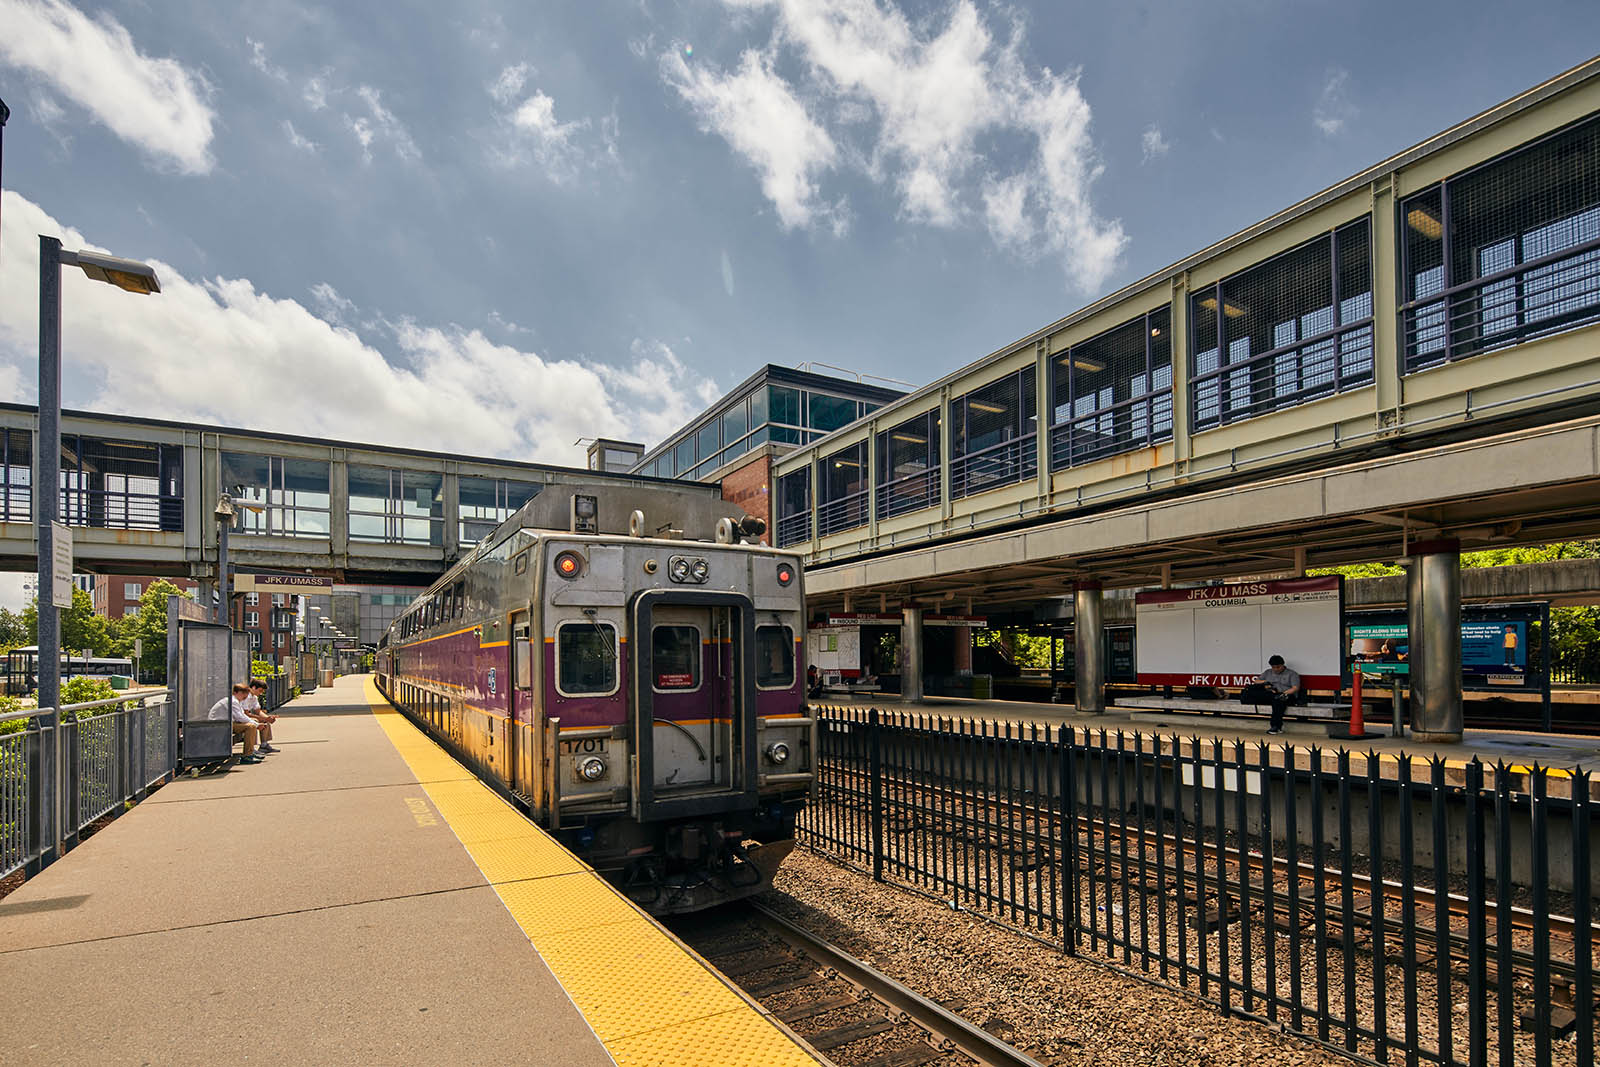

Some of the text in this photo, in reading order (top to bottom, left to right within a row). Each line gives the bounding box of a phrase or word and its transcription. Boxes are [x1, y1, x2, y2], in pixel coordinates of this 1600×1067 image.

[264, 576, 282, 584] JFK
[290, 577, 324, 586] UMASS
[1187, 583, 1268, 600] JFK / U MASS
[1204, 597, 1248, 608] COLUMBIA
[1188, 674, 1260, 686] JFK / U MAS
[564, 736, 604, 753] 1701
